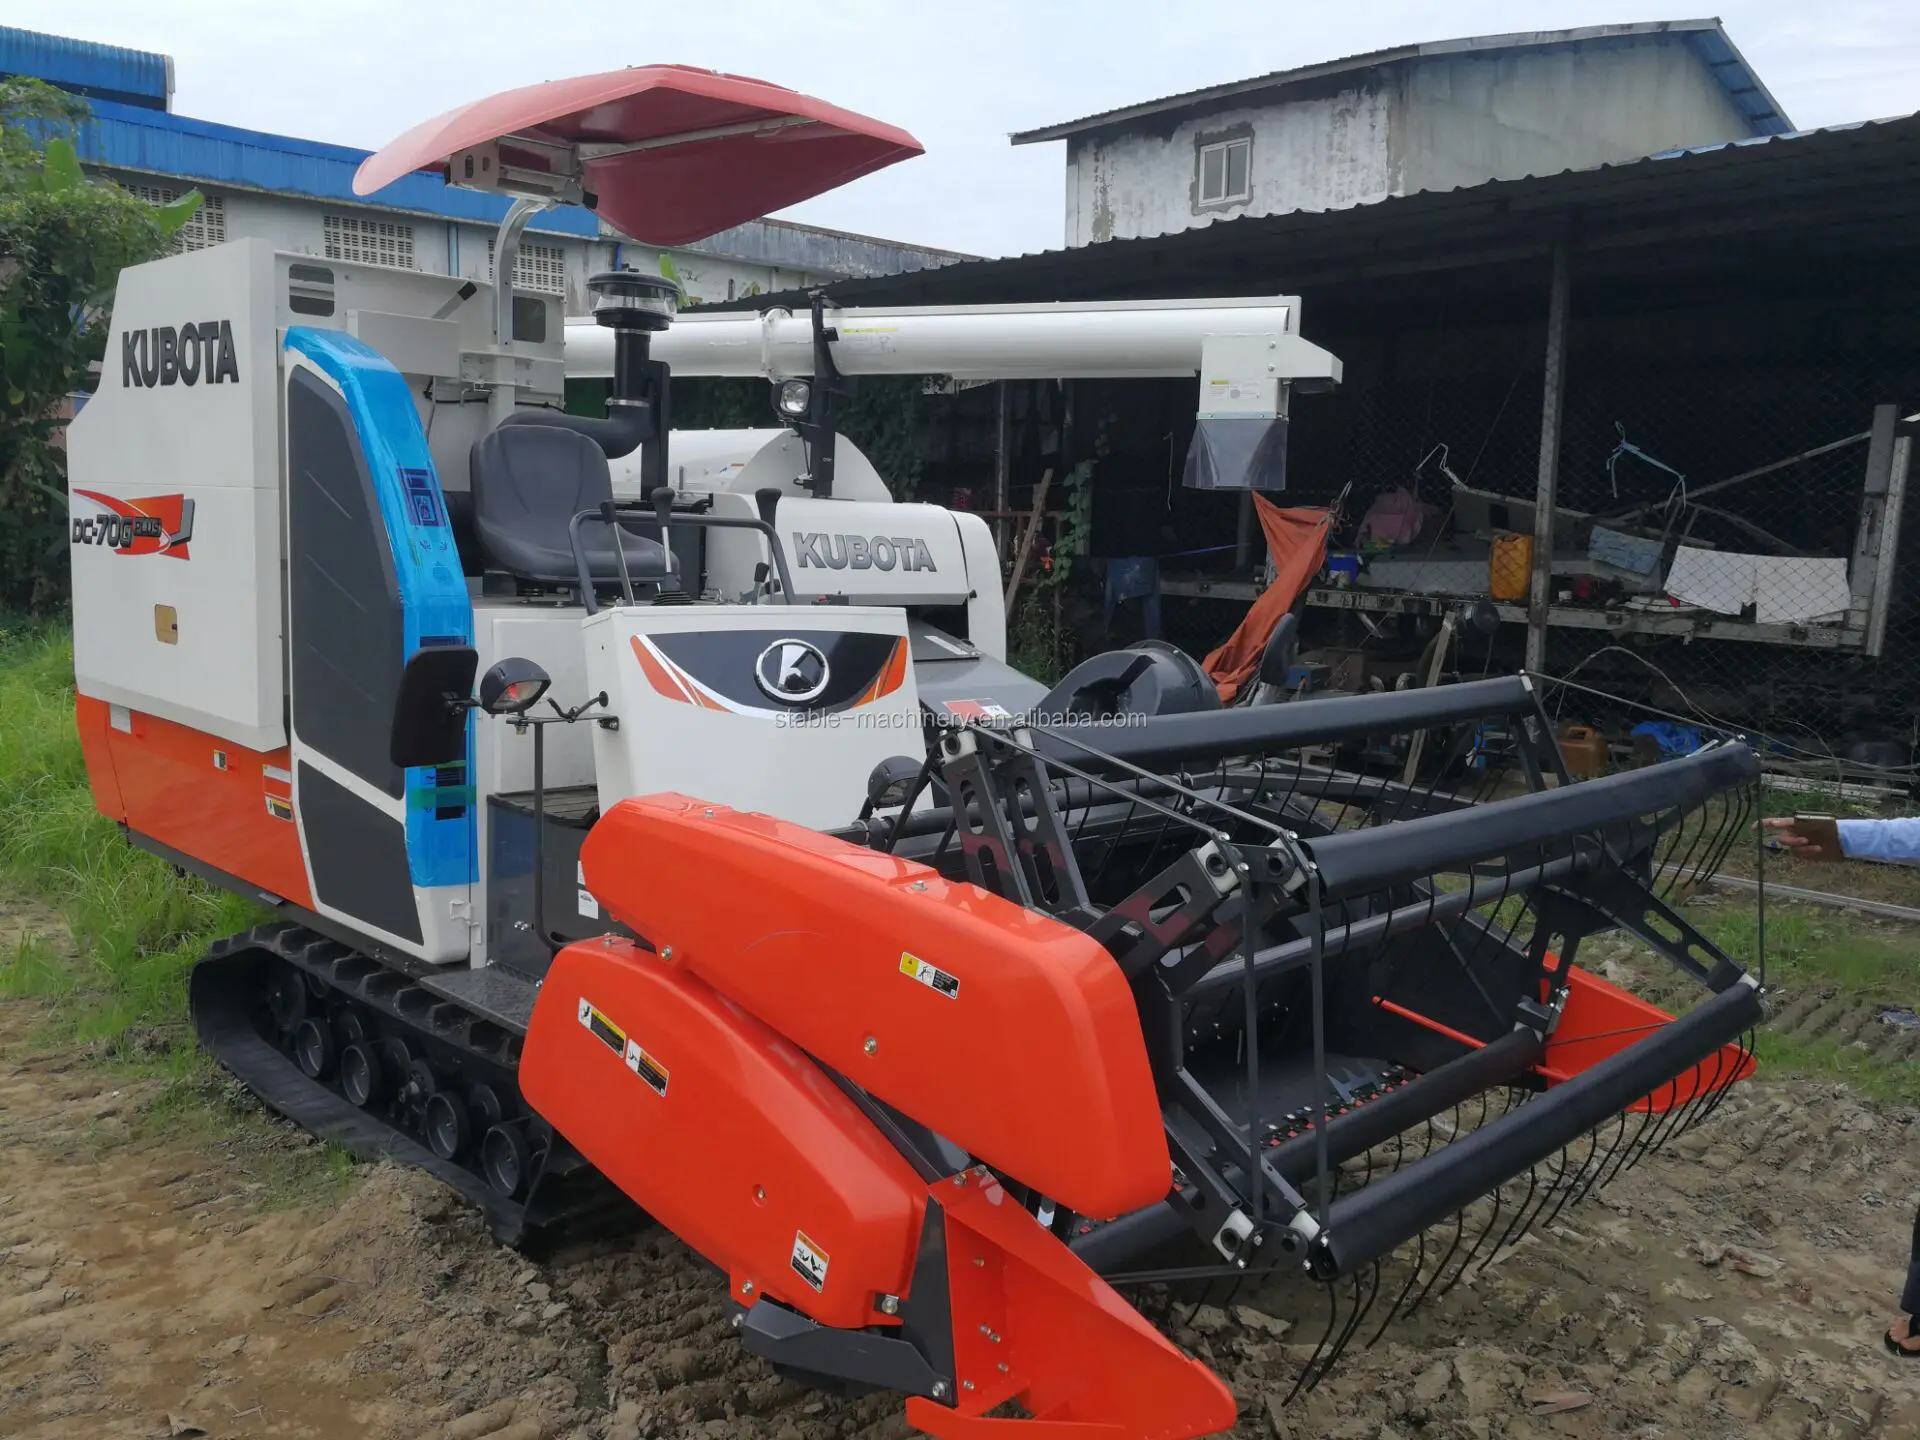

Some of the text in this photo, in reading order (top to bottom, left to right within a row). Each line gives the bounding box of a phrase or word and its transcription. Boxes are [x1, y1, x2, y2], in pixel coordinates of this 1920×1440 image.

[122, 319, 240, 388] KUBOTA
[72, 513, 161, 549] DC-70G PLUS
[792, 531, 937, 573] KUBOTA
